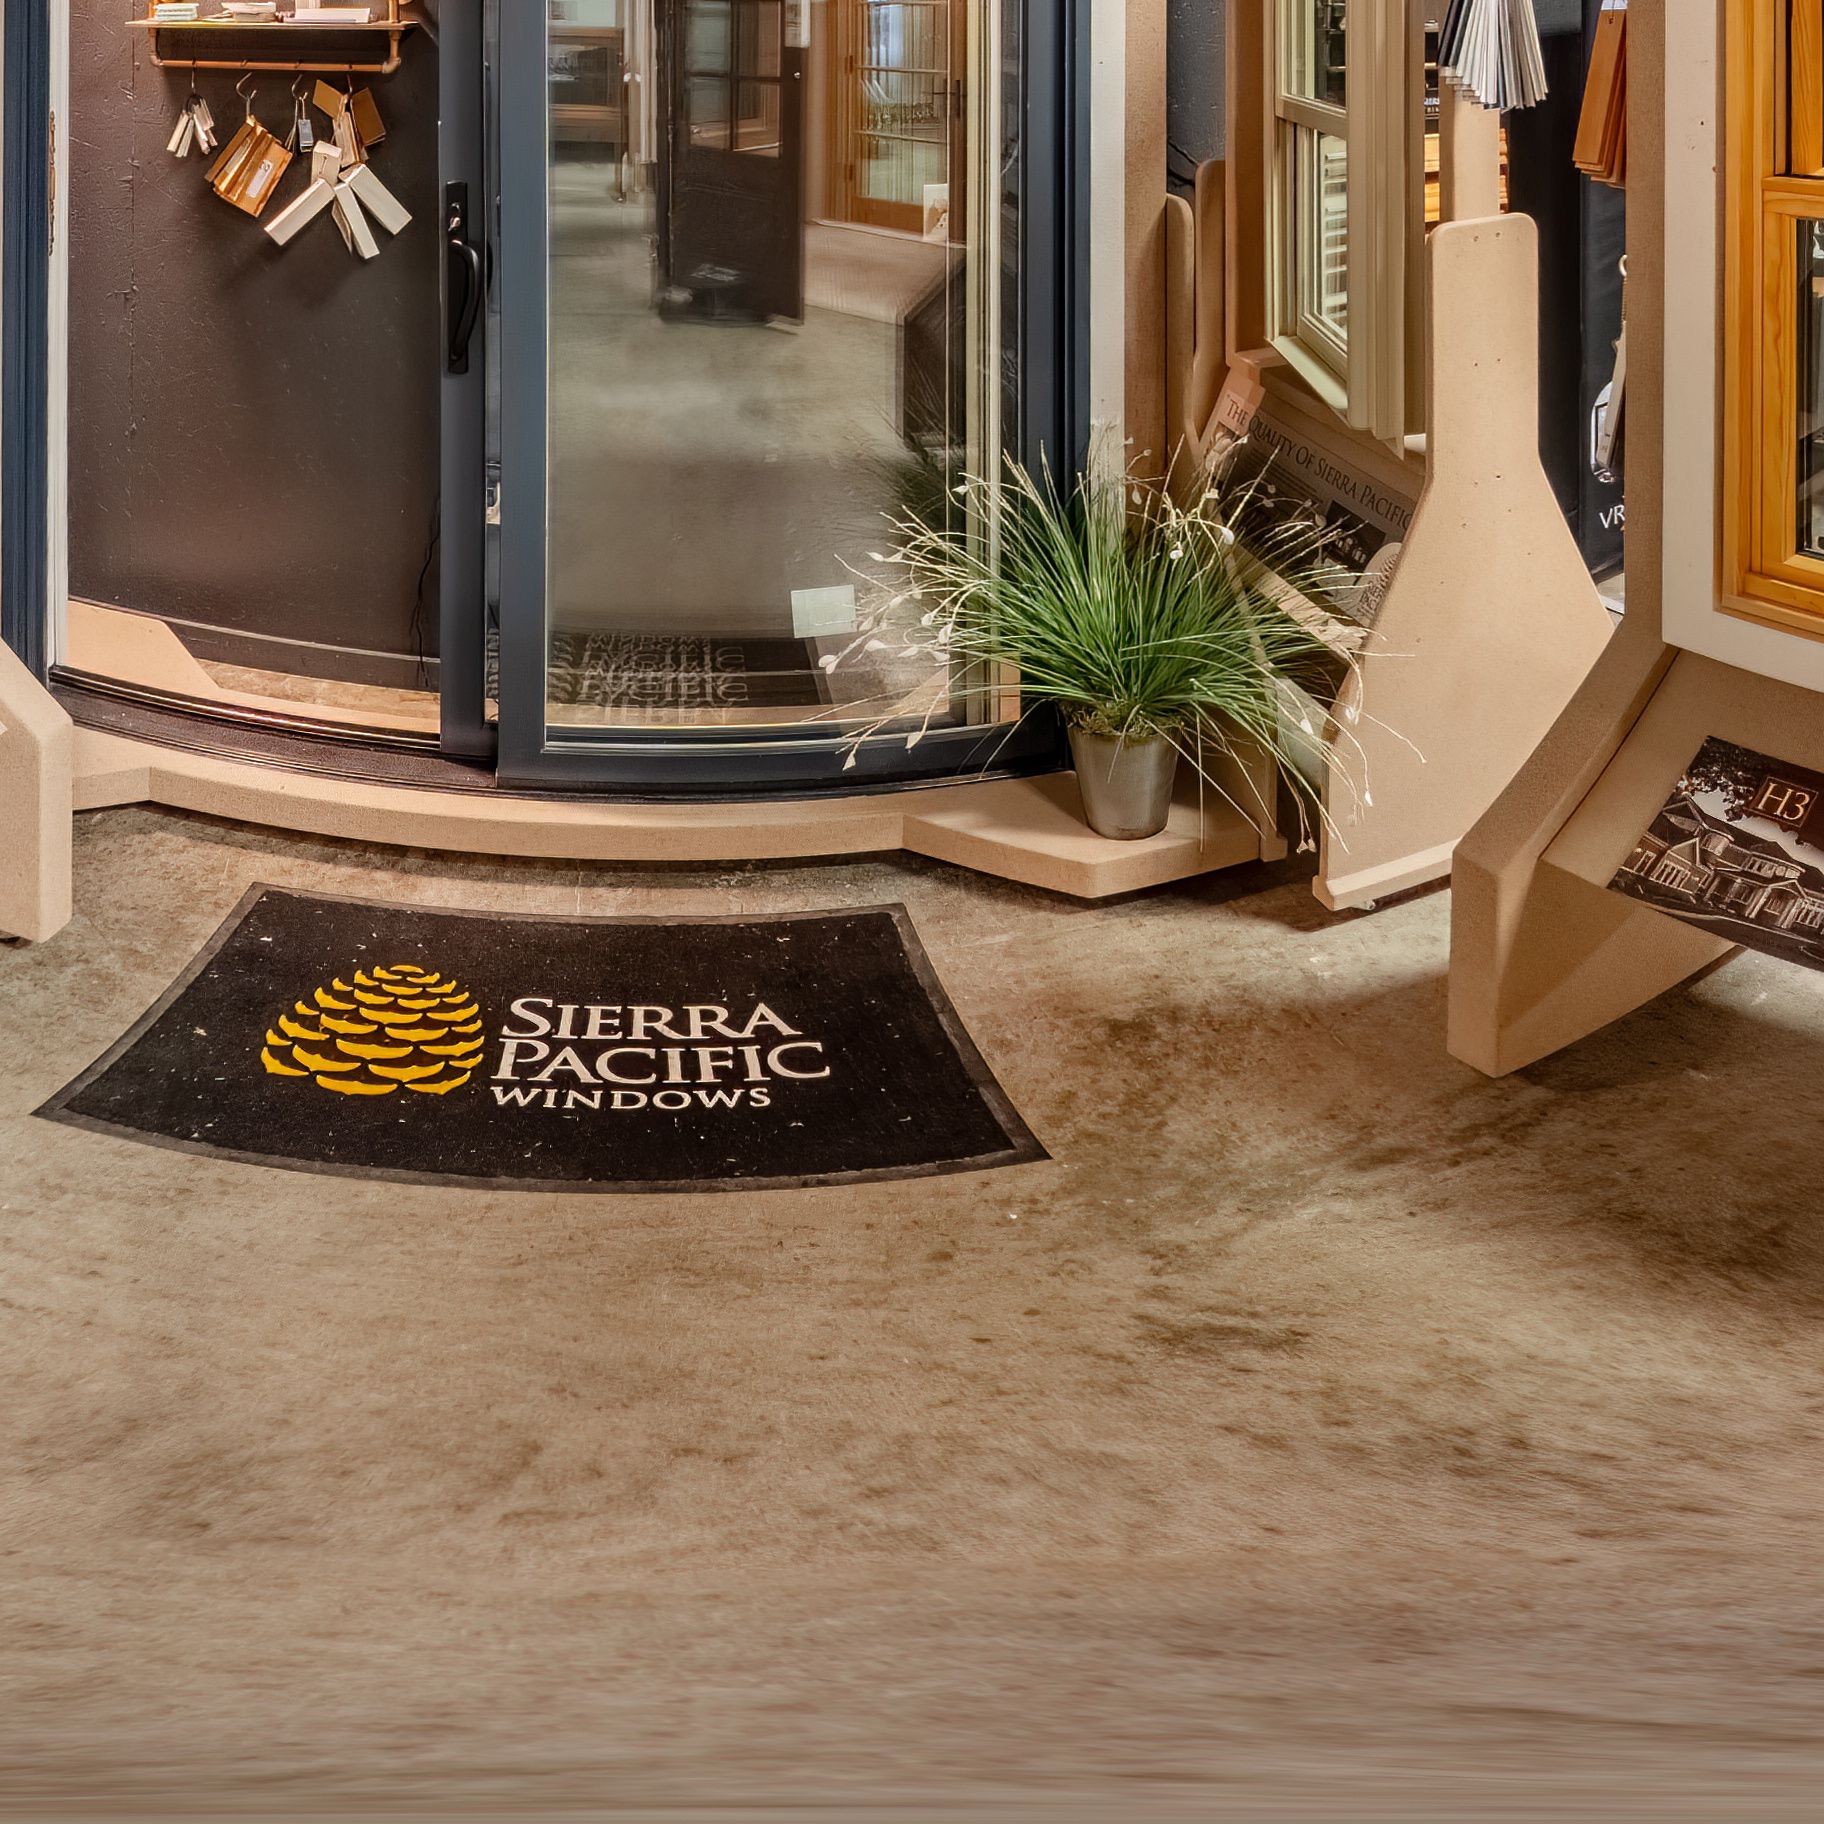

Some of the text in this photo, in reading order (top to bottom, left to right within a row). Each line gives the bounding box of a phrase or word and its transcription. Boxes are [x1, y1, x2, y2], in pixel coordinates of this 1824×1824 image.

[1757, 782, 1810, 820] H3
[501, 998, 804, 1042] SIERRA
[492, 1037, 831, 1086] PACIFIC
[492, 1085, 771, 1112] WINDOWS
